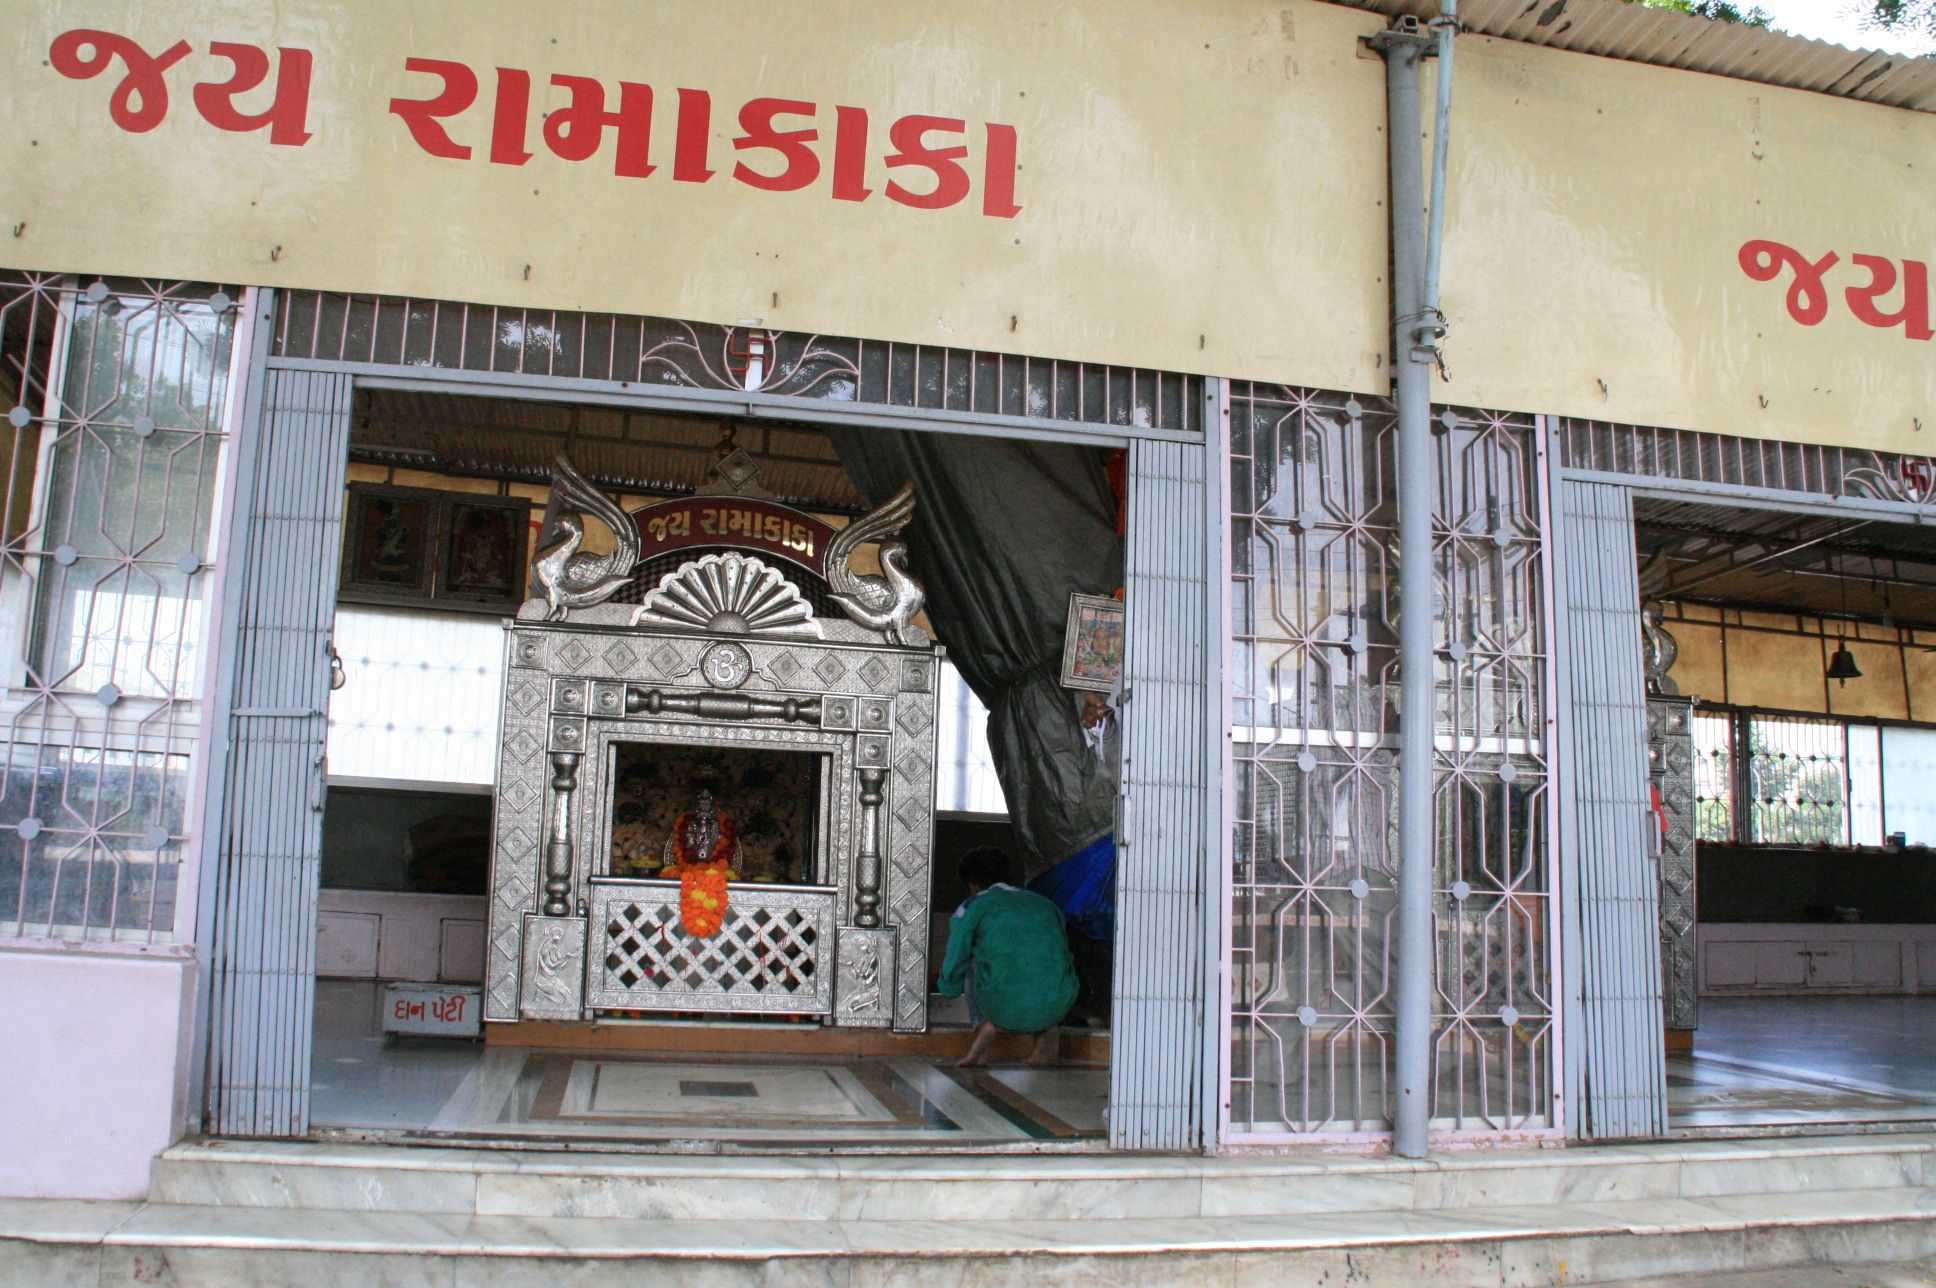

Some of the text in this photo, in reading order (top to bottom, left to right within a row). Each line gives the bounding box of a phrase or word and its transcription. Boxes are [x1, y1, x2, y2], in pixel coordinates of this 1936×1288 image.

[49, 28, 1023, 219] જય રામાકાકા
[1738, 239, 1935, 341] જય
[648, 508, 814, 558] જય રામાકાકા
[394, 995, 466, 1022] દાન પેટી
